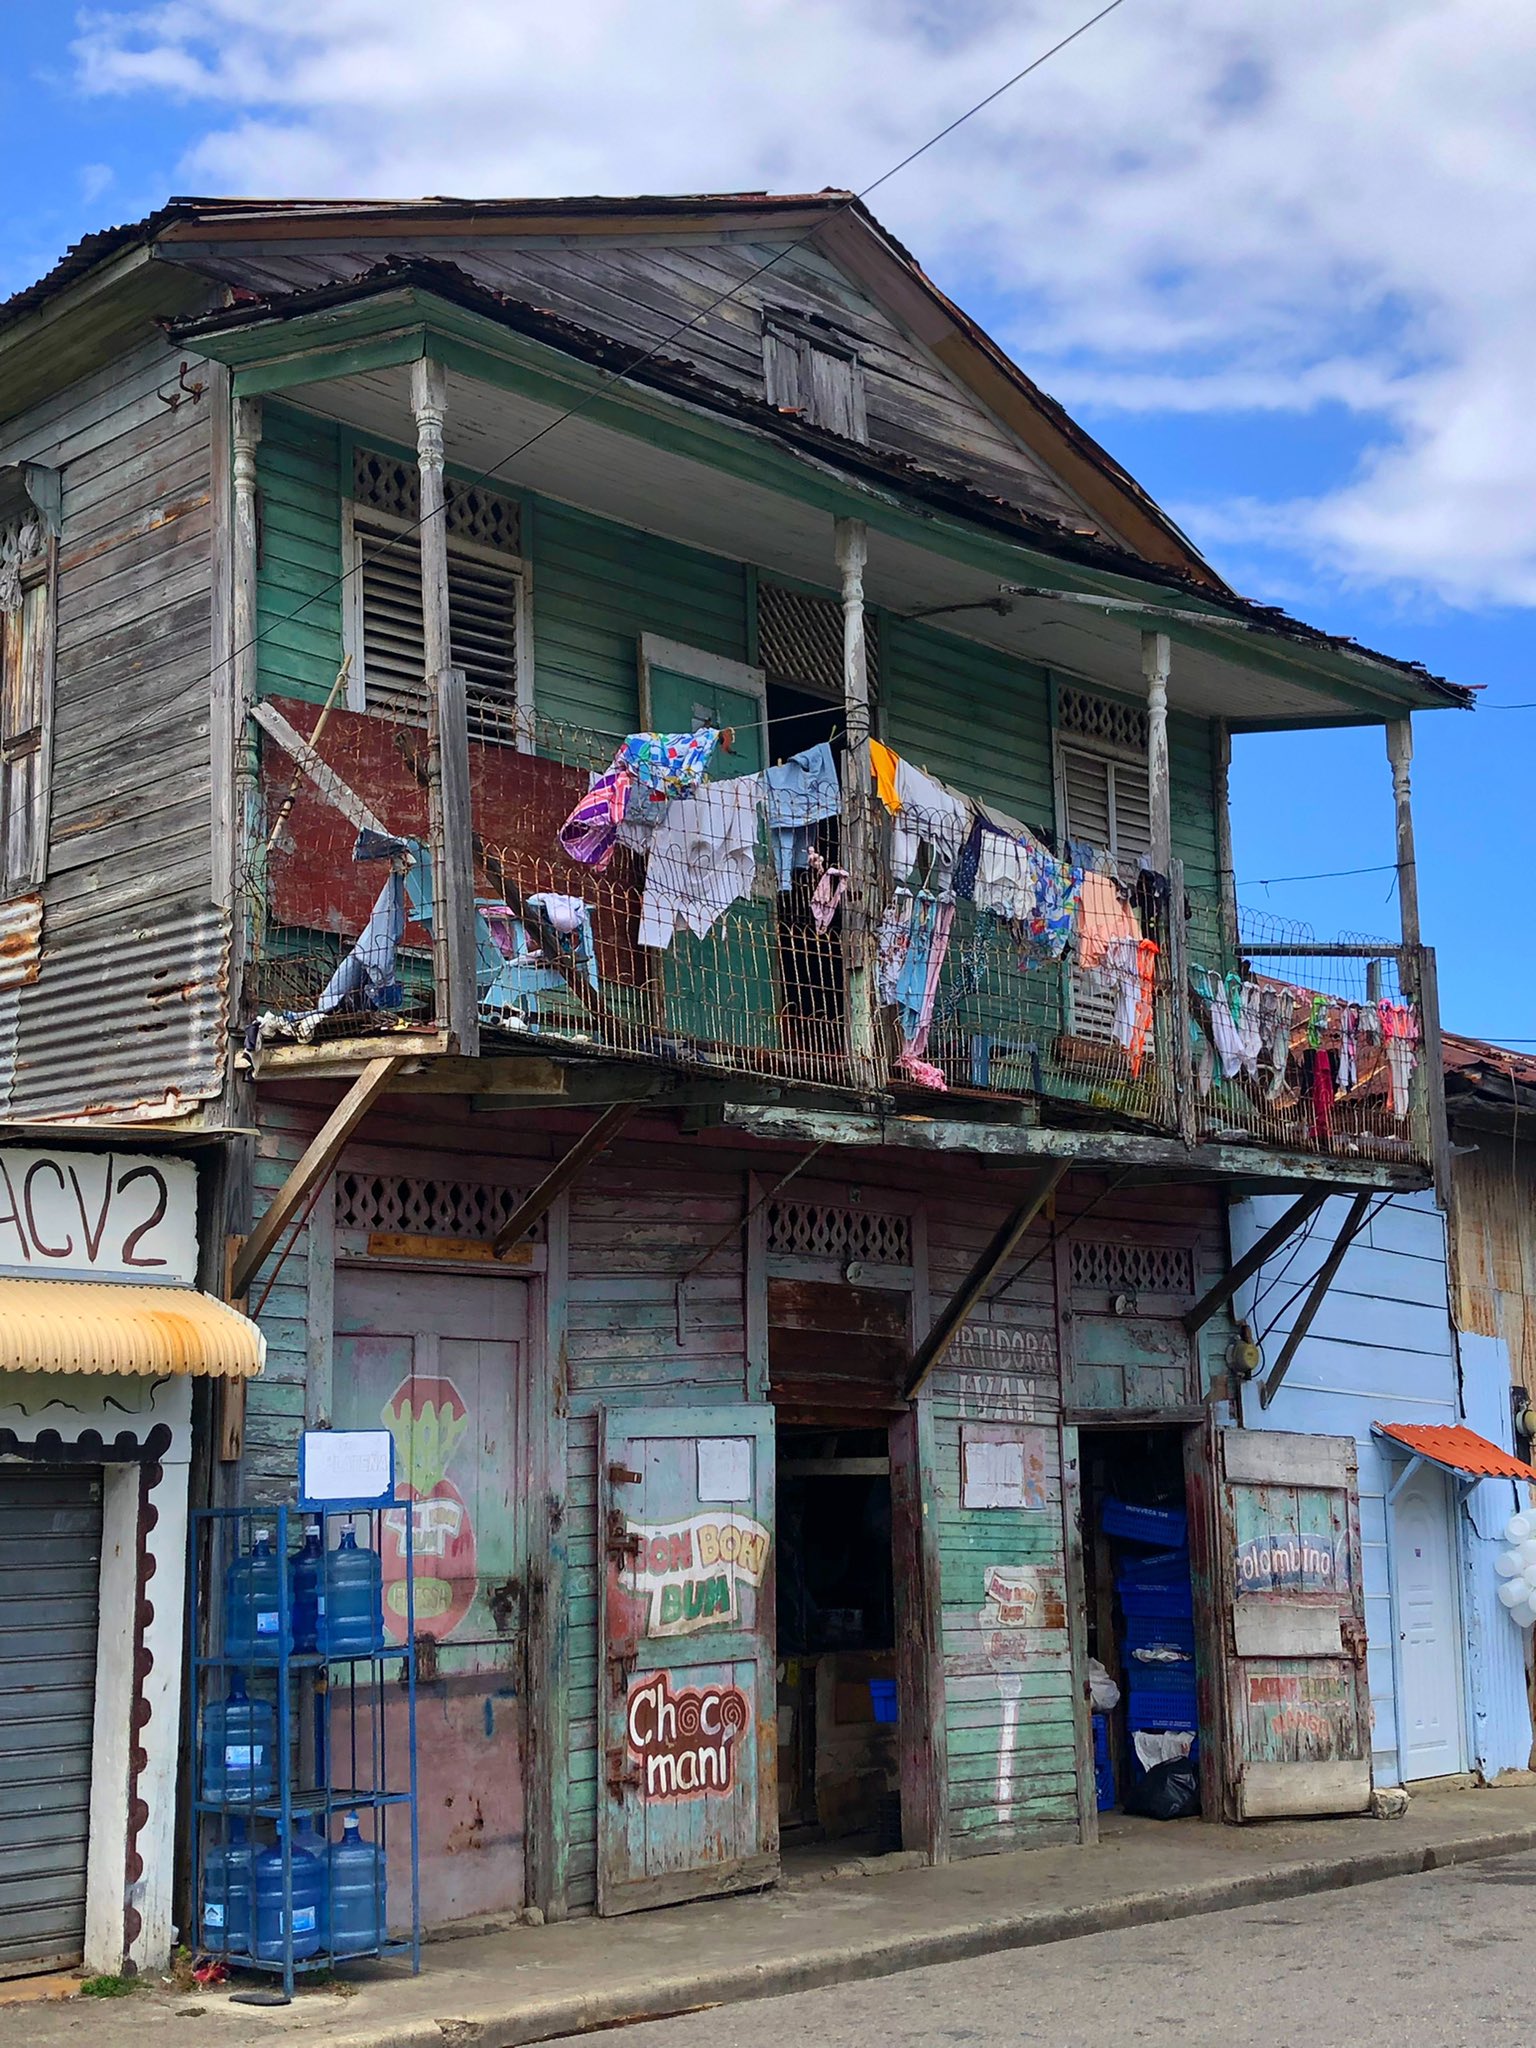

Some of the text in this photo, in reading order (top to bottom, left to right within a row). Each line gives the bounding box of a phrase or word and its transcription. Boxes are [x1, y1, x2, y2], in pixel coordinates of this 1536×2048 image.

[938, 1325, 1054, 1372] URTIDORA
[696, 1524, 766, 1575] BON
[659, 1574, 731, 1627] BUM
[629, 1683, 743, 1747] Choco
